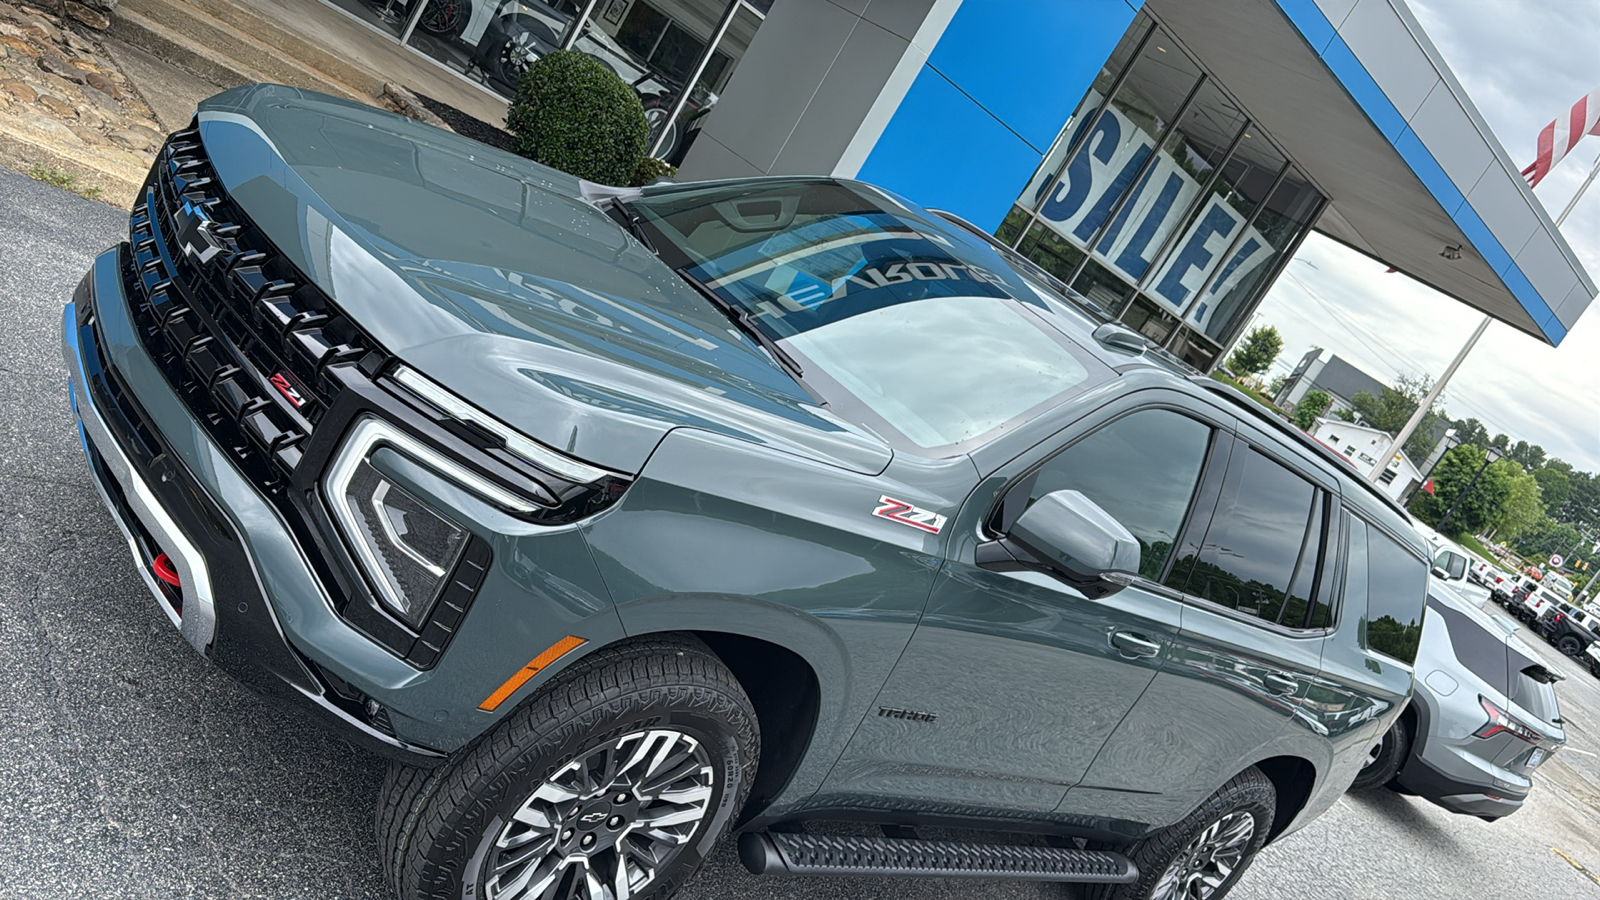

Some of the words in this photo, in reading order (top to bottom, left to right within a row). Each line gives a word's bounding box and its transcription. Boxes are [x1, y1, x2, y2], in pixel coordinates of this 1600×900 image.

[270, 373, 306, 408] Z71
[871, 494, 948, 535] Z71
[878, 706, 939, 722] TAHOE
